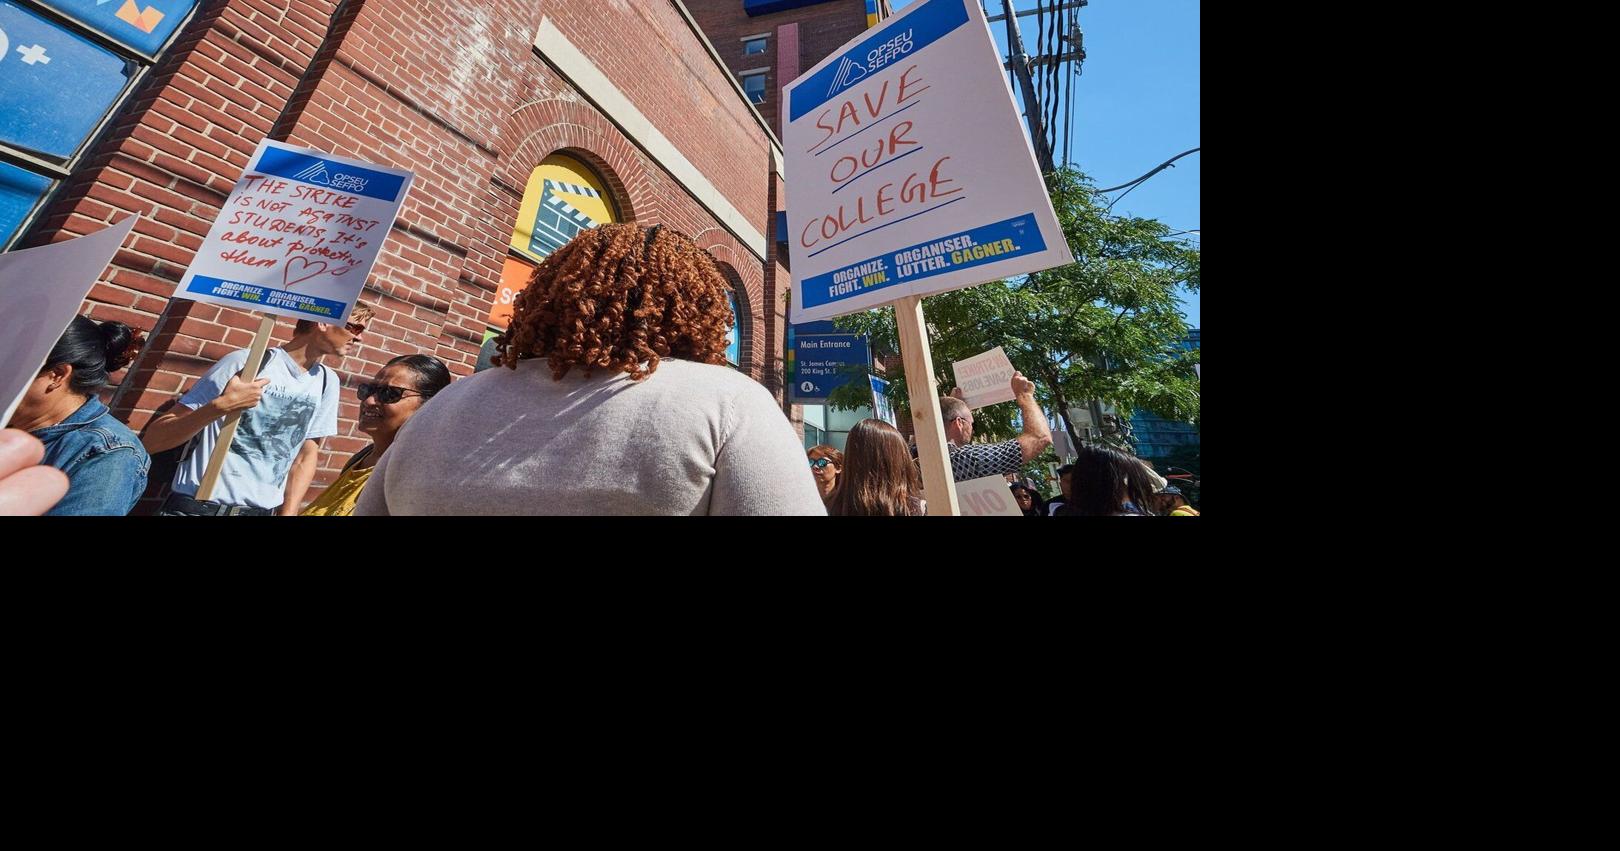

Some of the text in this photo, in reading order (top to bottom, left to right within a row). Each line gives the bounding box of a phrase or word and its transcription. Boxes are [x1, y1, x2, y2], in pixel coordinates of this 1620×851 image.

[867, 28, 914, 62] OPSEU
[868, 40, 914, 73] SEFPO
[807, 65, 930, 153] SAVE
[830, 121, 918, 182] OUR
[329, 179, 364, 192] SEFPO
[334, 173, 369, 186] OPSEU
[244, 174, 359, 209] THE STRIKE
[256, 199, 293, 213] NOT
[801, 156, 964, 249] COLLEGE
[221, 231, 284, 248] about
[329, 231, 368, 249] It's
[221, 249, 278, 268] them
[895, 234, 978, 265] ORGANISER.
[896, 238, 1021, 279] LUTTER. GAGNER.
[833, 258, 889, 284] ORGANIZE.
[220, 281, 265, 296] ORGANIZE.
[829, 270, 890, 298] FIGHT. WIN.
[212, 287, 261, 302] FIGHT. WIN.
[269, 290, 317, 306] ORGANISER.
[266, 296, 298, 309] LUTTER.
[298, 302, 332, 316] GAGNER.
[801, 340, 851, 349] Main Entrance
[812, 368, 824, 376] King
